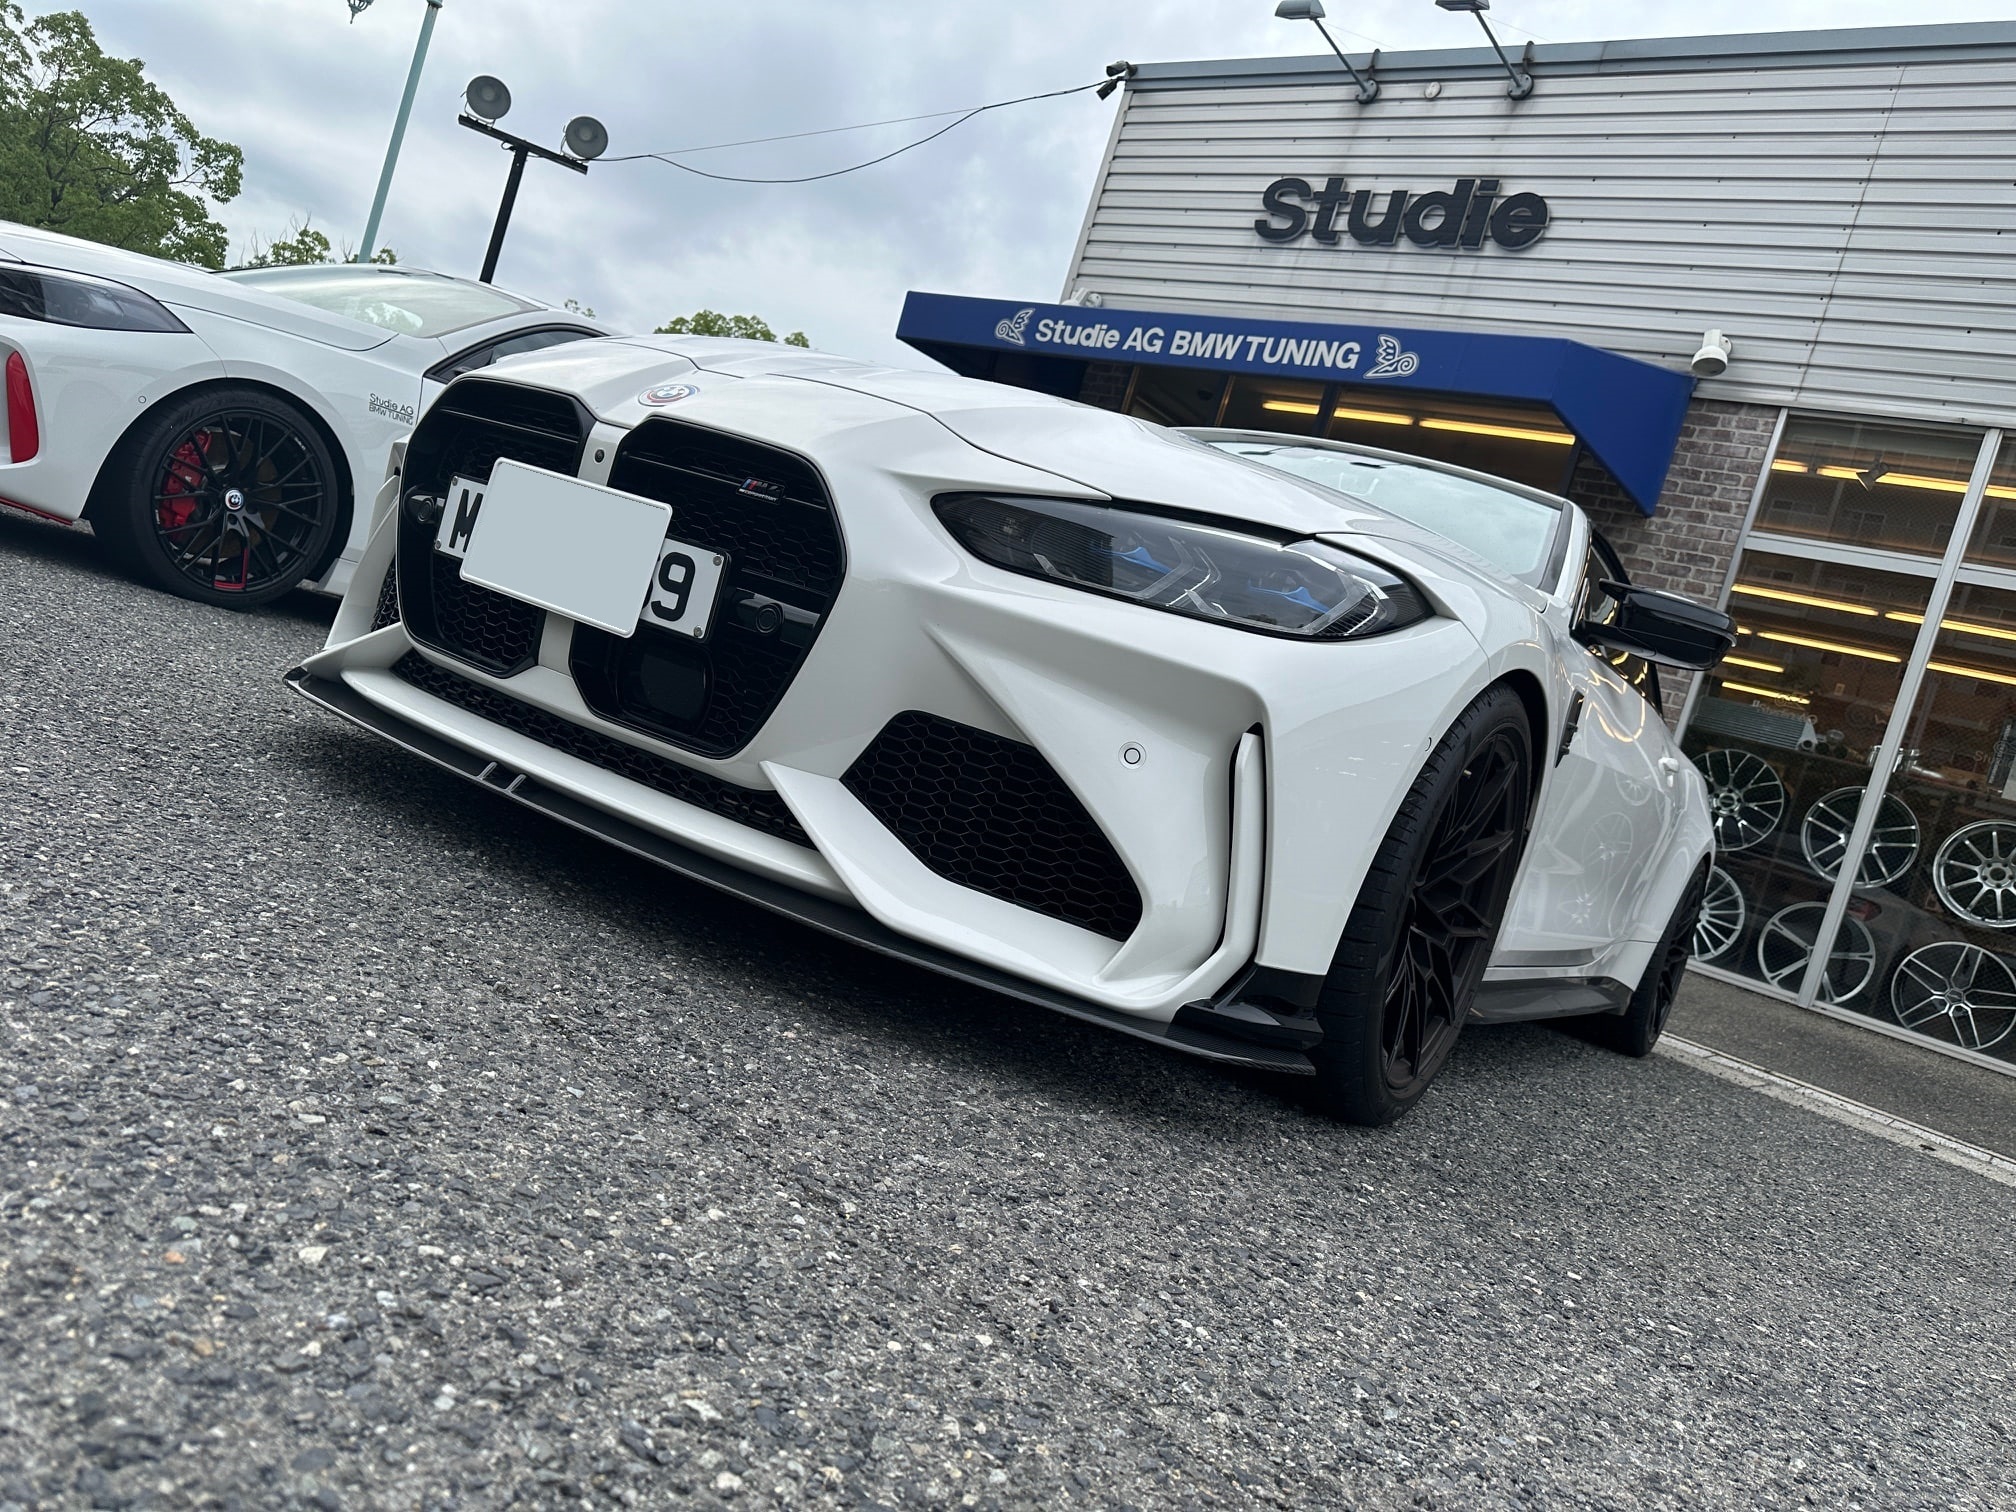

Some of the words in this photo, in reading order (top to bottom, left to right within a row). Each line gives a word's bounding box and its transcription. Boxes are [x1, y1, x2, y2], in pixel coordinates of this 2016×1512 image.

[1254, 177, 1549, 250] Studie
[1035, 318, 1120, 349] Studie
[1122, 326, 1165, 354] AG
[1169, 330, 1244, 361] BMW
[1246, 335, 1361, 370] TUNING
[369, 393, 398, 411] Studie
[400, 404, 414, 416] AG
[369, 404, 386, 416] BMW
[388, 410, 414, 426] TUNING
[642, 551, 696, 622] 9
